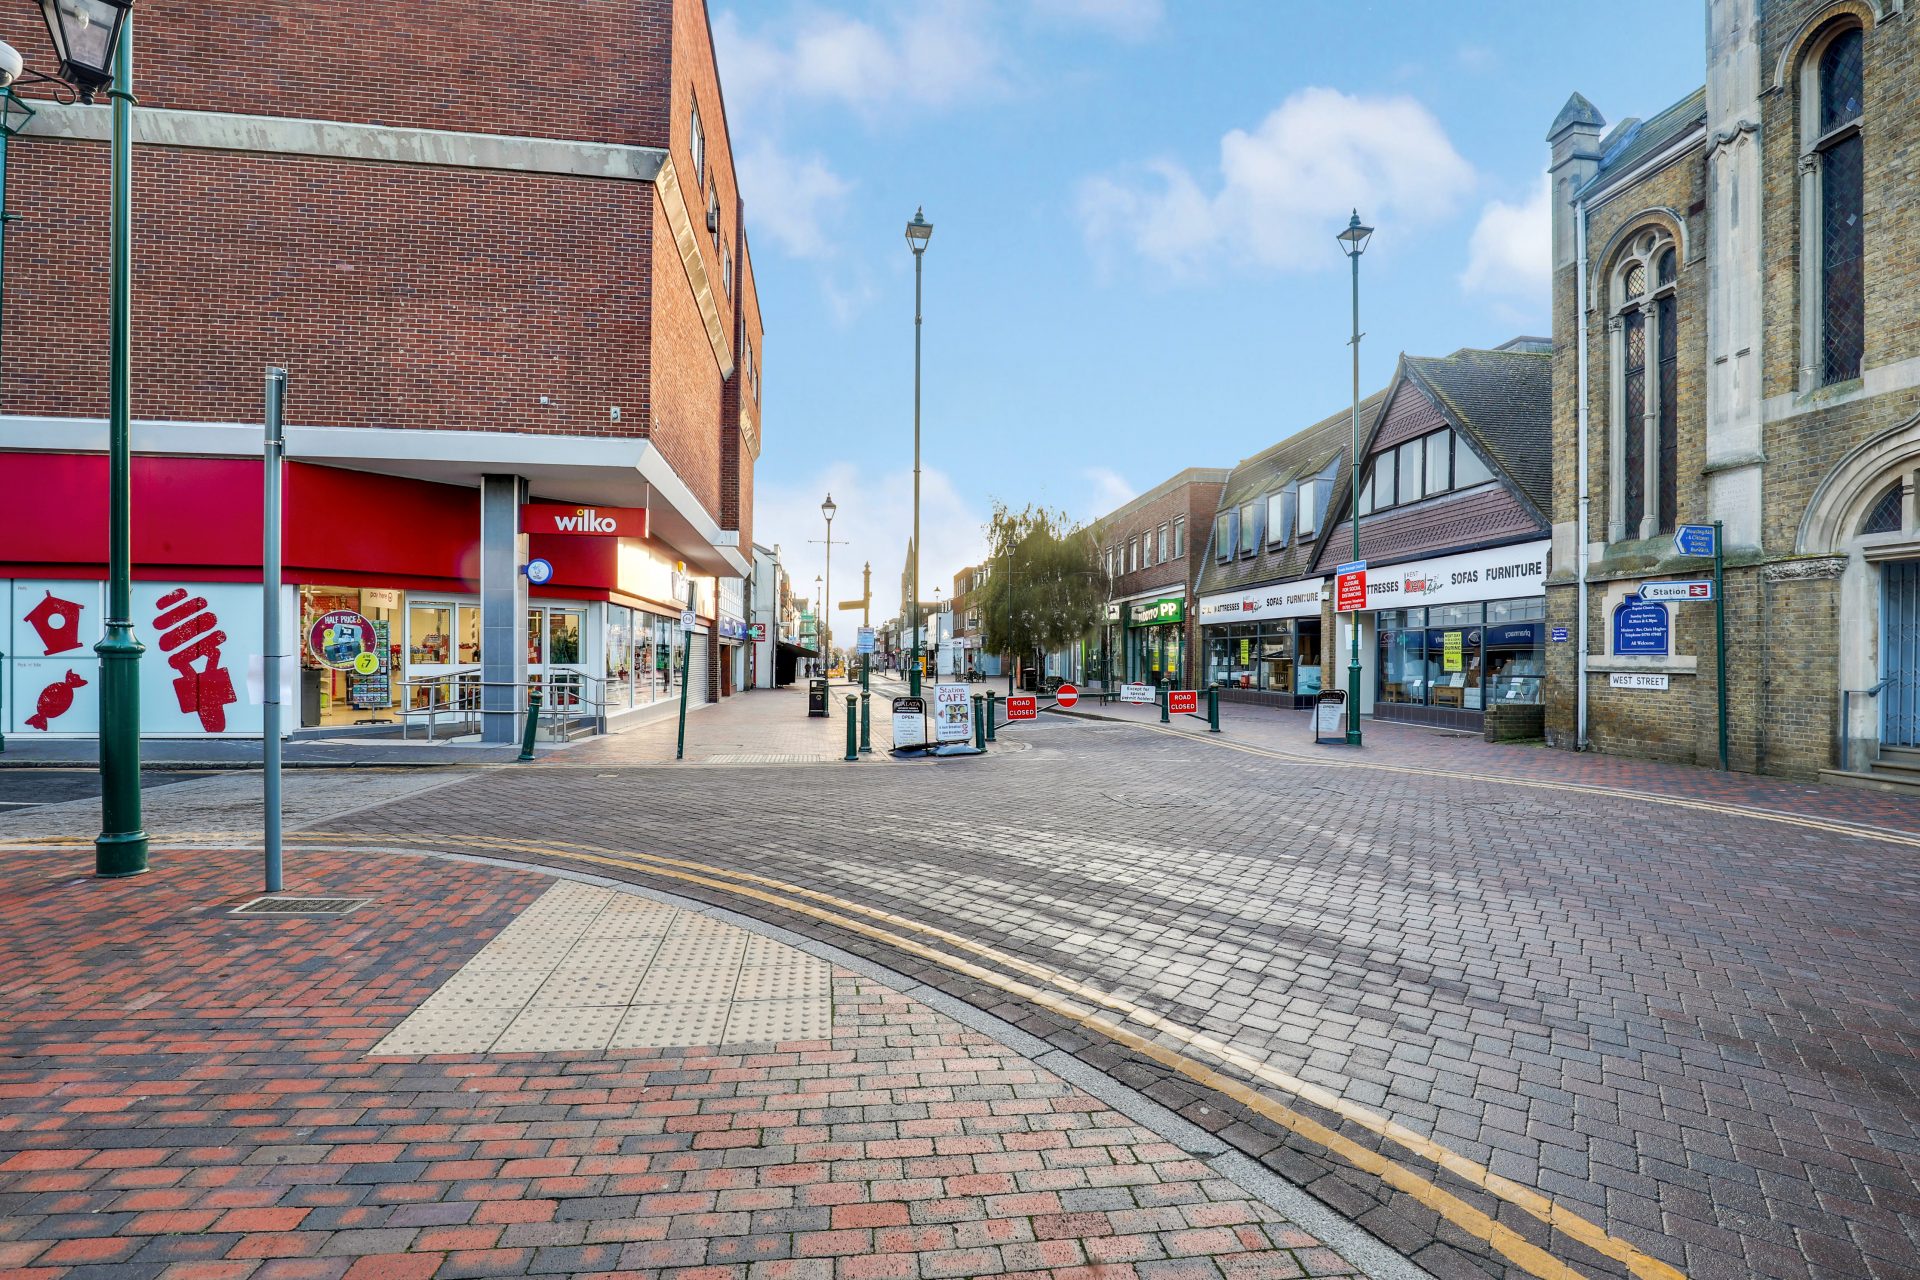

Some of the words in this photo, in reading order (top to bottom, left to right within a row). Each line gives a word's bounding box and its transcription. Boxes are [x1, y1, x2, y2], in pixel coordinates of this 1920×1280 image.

[555, 509, 617, 533] wilko
[1451, 570, 1478, 585] SOFAS
[1485, 561, 1542, 581] FURNITURE
[1366, 581, 1399, 595] TTRESSES
[1266, 597, 1283, 607] SOFAS
[1160, 602, 1176, 616] PP
[325, 616, 339, 624] HALF
[1613, 676, 1632, 684] WEST
[1637, 677, 1665, 686] STREET
[939, 686, 965, 694] Station
[938, 693, 966, 702] CAFE
